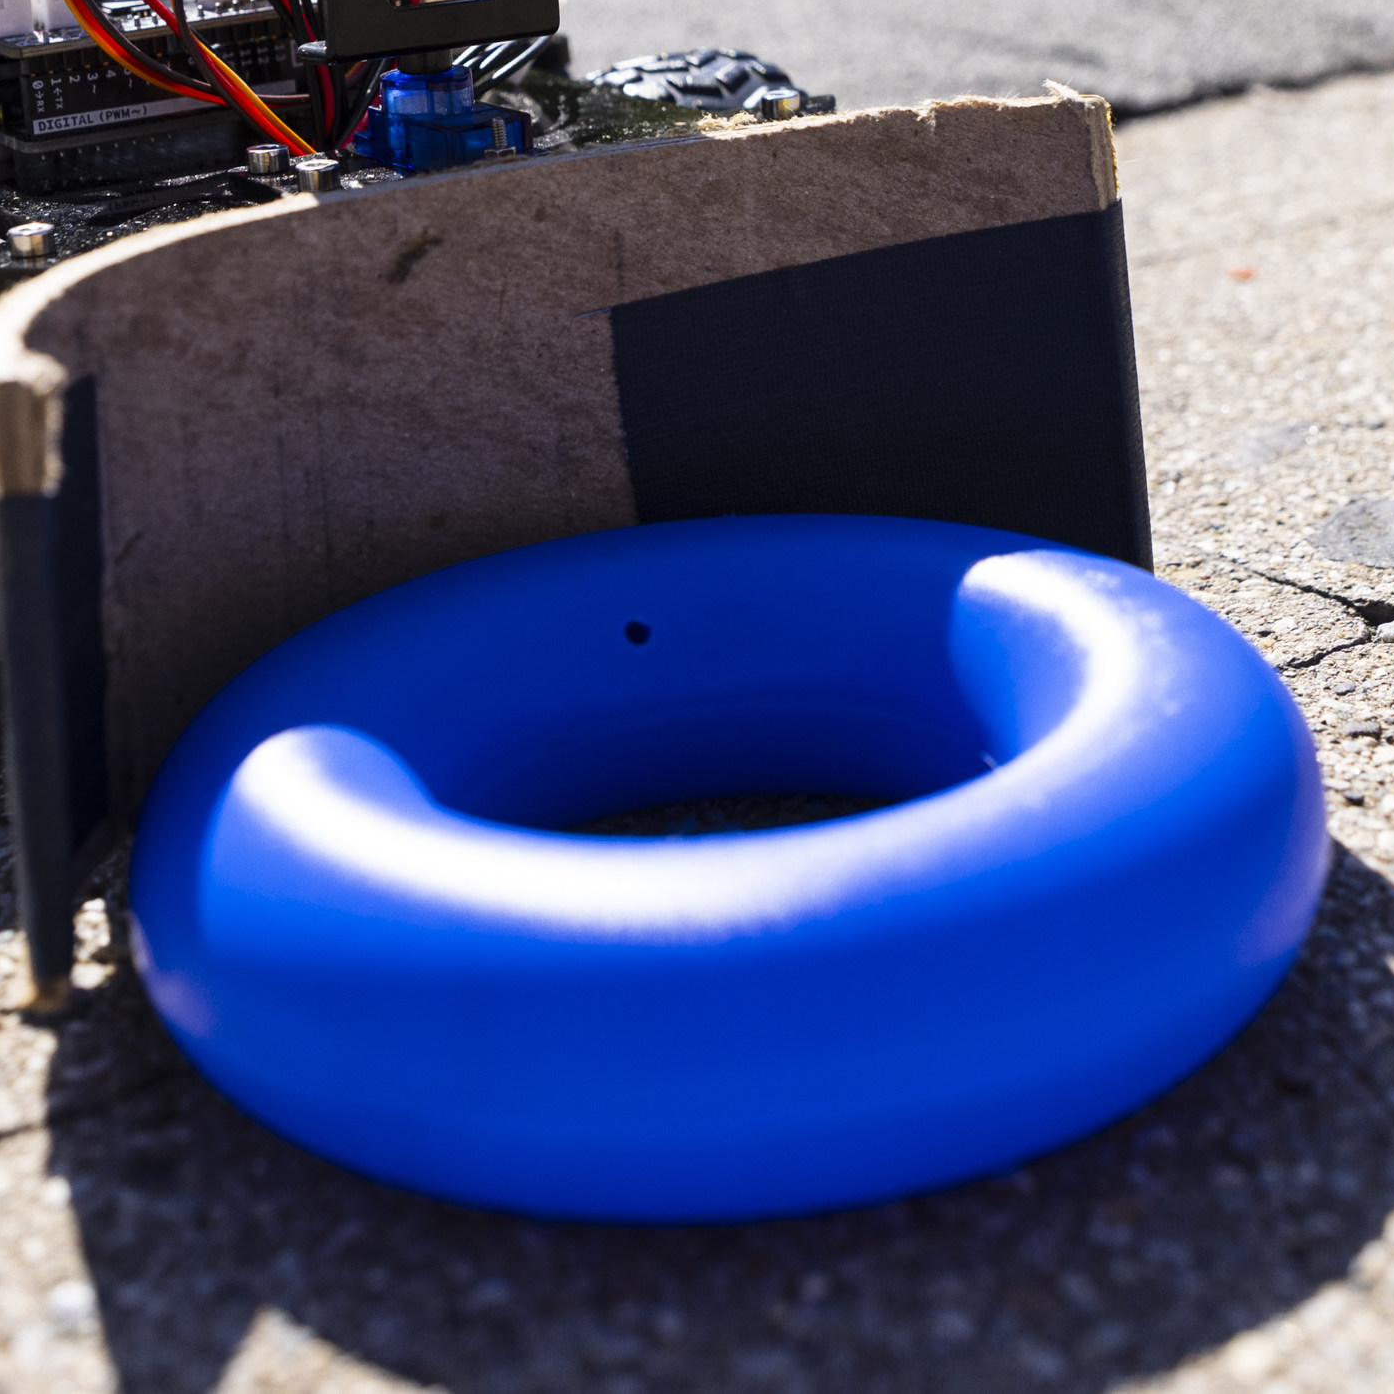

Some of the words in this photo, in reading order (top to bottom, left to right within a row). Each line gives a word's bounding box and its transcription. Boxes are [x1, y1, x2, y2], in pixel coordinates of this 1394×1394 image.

[106, 69, 117, 79] 4
[69, 75, 80, 84] 2
[38, 114, 94, 132] DIGITAL
